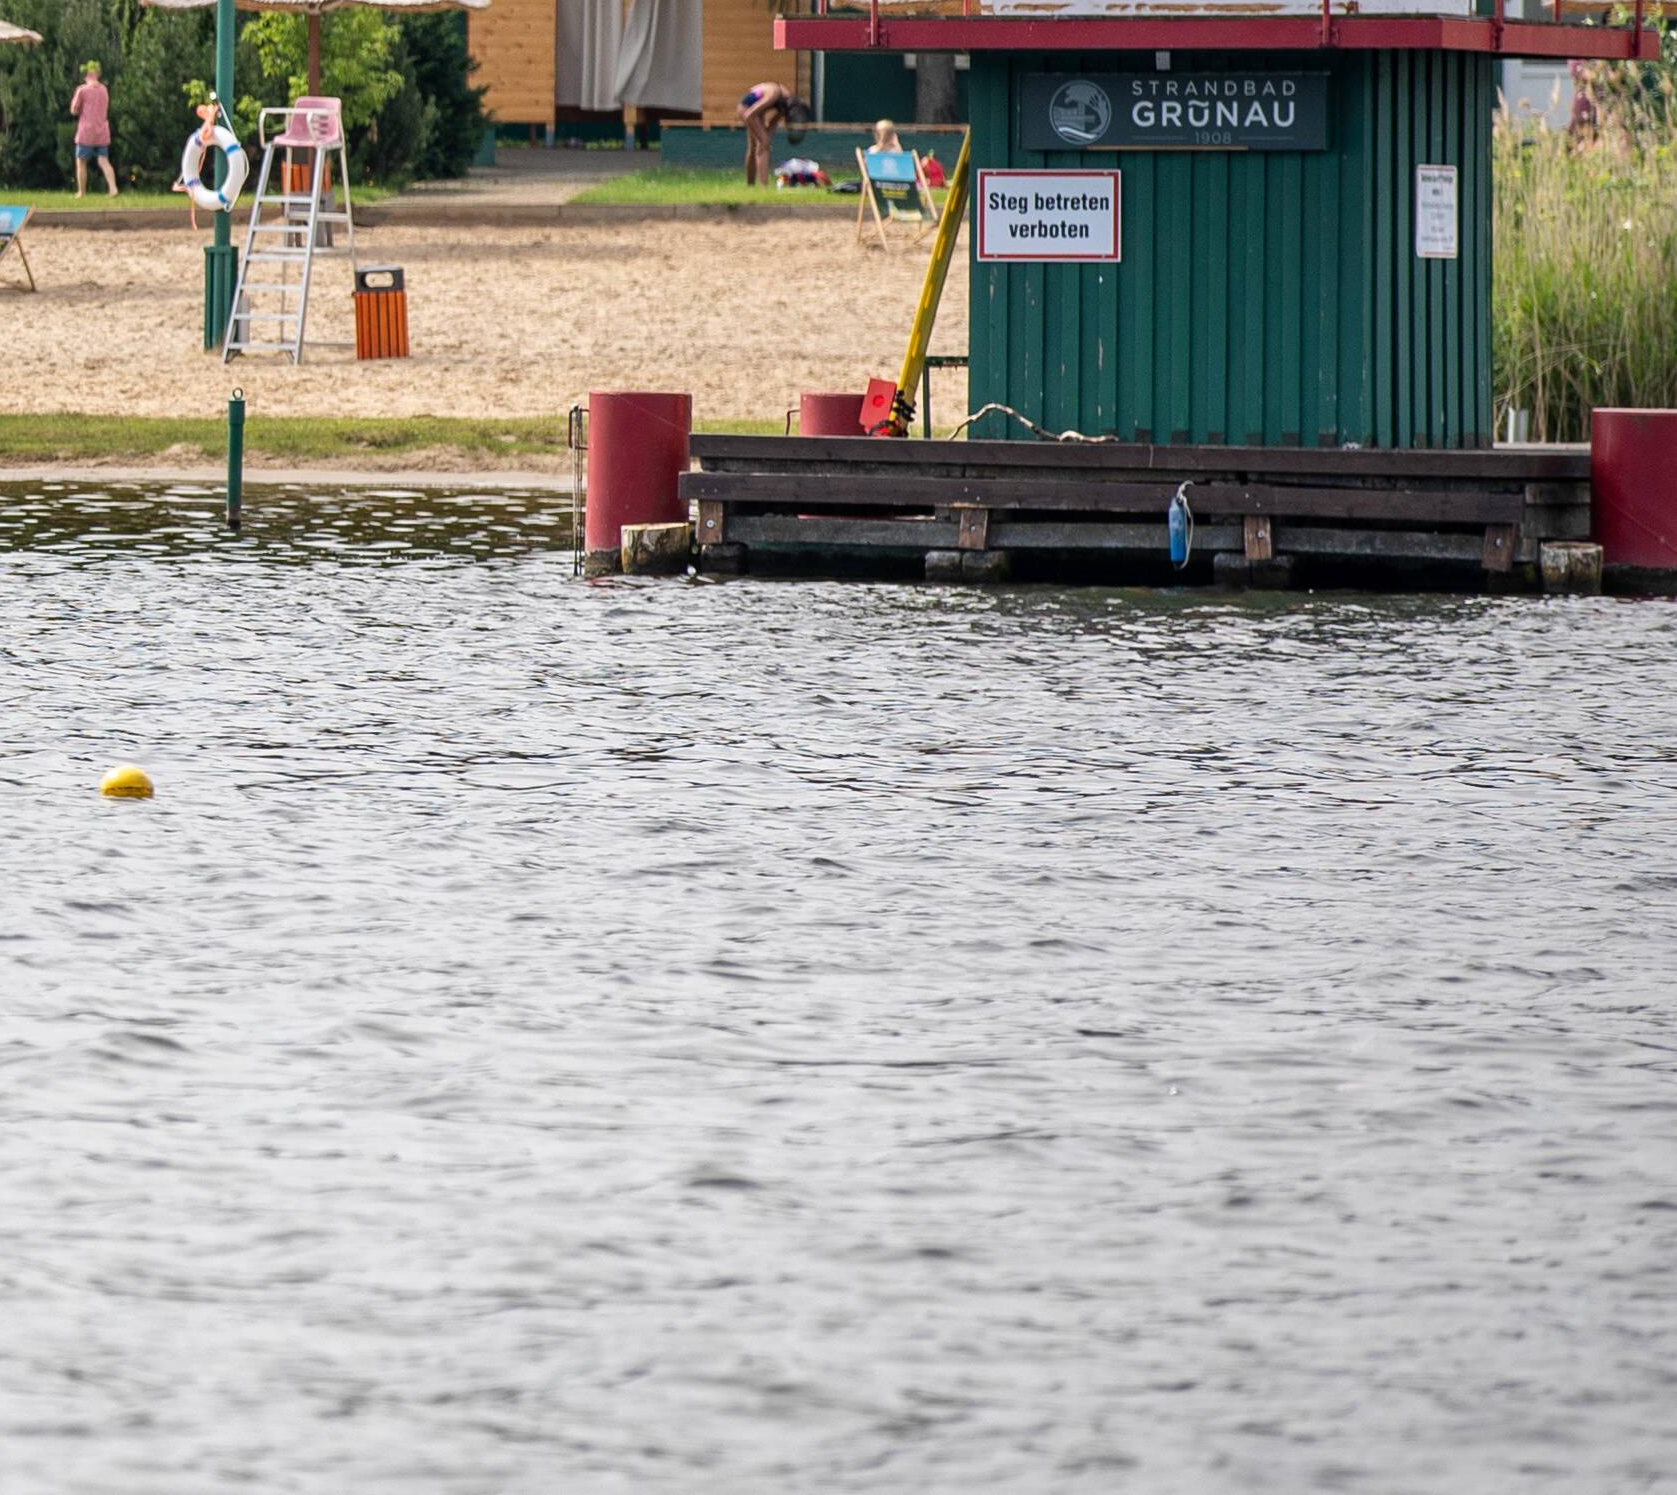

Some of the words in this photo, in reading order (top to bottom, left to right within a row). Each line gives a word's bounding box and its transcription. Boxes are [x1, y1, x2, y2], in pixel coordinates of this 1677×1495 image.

[1132, 80, 1296, 96] STRANDBAD
[1195, 131, 1232, 145] 1908
[989, 192, 1028, 215] Steg
[1034, 192, 1110, 211] betreten
[1009, 219, 1090, 239] verboten
